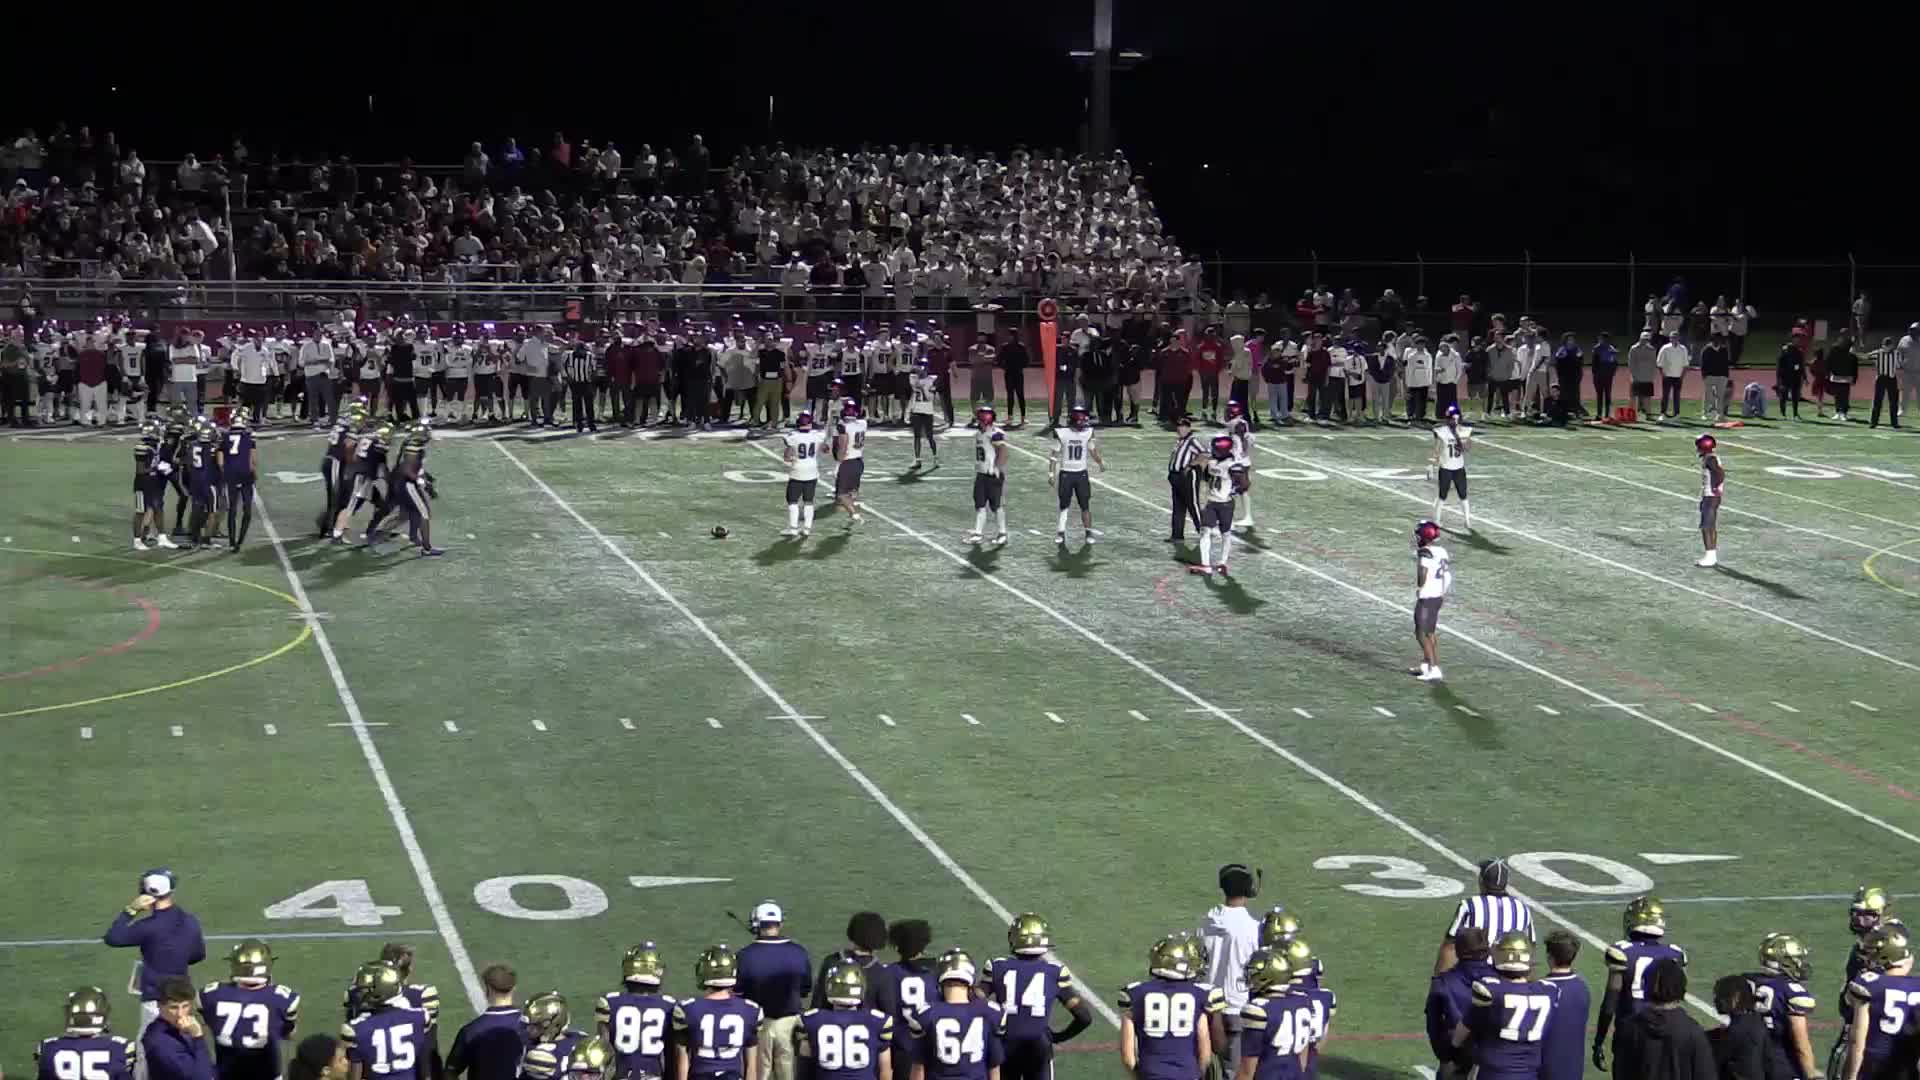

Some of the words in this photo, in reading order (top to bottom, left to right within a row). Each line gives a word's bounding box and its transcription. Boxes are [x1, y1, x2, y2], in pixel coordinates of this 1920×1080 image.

[192, 446, 202, 468] 5
[228, 435, 241, 455] 7
[797, 442, 816, 460] 94
[1067, 445, 1082, 460] 10
[900, 976, 926, 1013] 9
[1002, 969, 1046, 1017] 14
[1144, 992, 1196, 1037] 88
[215, 1001, 269, 1049] 73
[614, 1005, 666, 1055] 82
[697, 1013, 745, 1059] 13
[935, 1016, 985, 1065] 64
[1271, 1006, 1314, 1056] 46
[1499, 994, 1551, 1042] 77
[53, 1050, 111, 1080] 95
[370, 1023, 416, 1074] 15
[817, 1024, 871, 1070] 86
